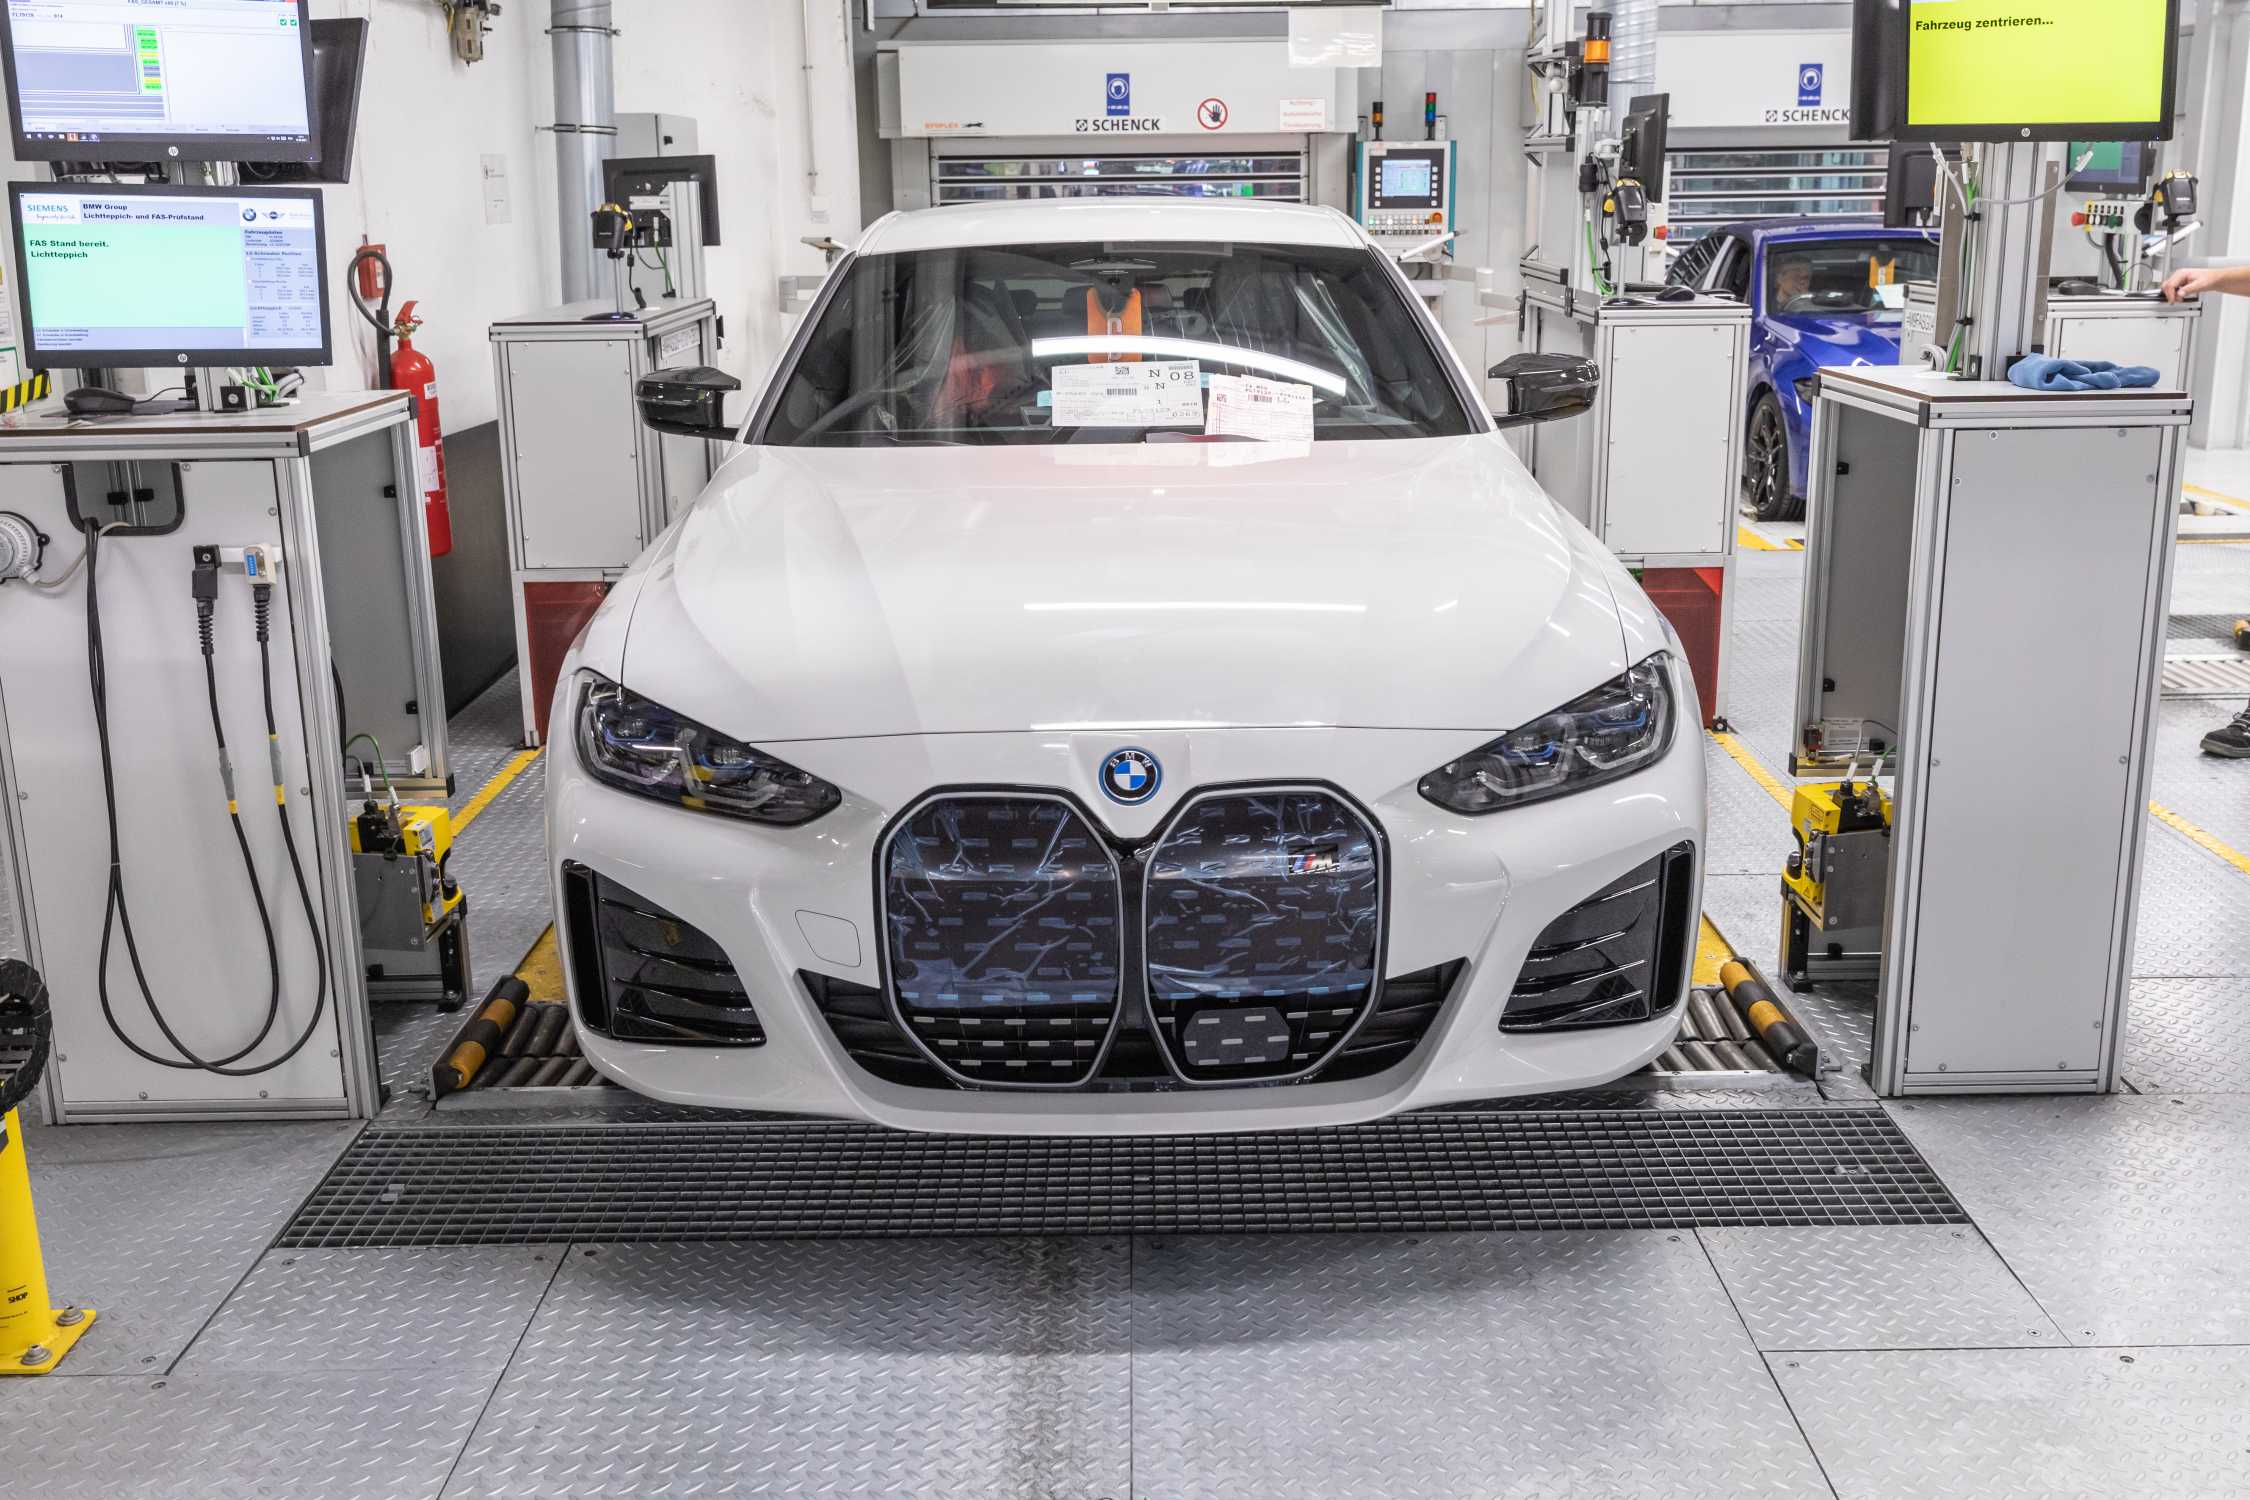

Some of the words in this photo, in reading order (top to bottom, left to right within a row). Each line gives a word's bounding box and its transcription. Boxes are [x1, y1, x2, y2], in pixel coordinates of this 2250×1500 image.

[1915, 20, 1972, 31] Fahrzeug
[1975, 16, 2054, 28] zentrieren...
[1782, 109, 1850, 122] SCHENCK
[1092, 118, 1160, 131] SCHENCK
[27, 204, 70, 213] SIEMENS
[83, 203, 102, 211] BMW
[104, 204, 128, 212] Group
[83, 213, 133, 221] Lichtteppich-
[29, 239, 48, 247] FAS
[50, 239, 77, 247] Stand
[79, 240, 110, 248] bereit.
[31, 250, 88, 259] Lichtteppich
[1149, 369, 1161, 378] N
[1155, 382, 1166, 390] N
[1110, 752, 1152, 768] BMW
[8, 1292, 28, 1304] SHOP
